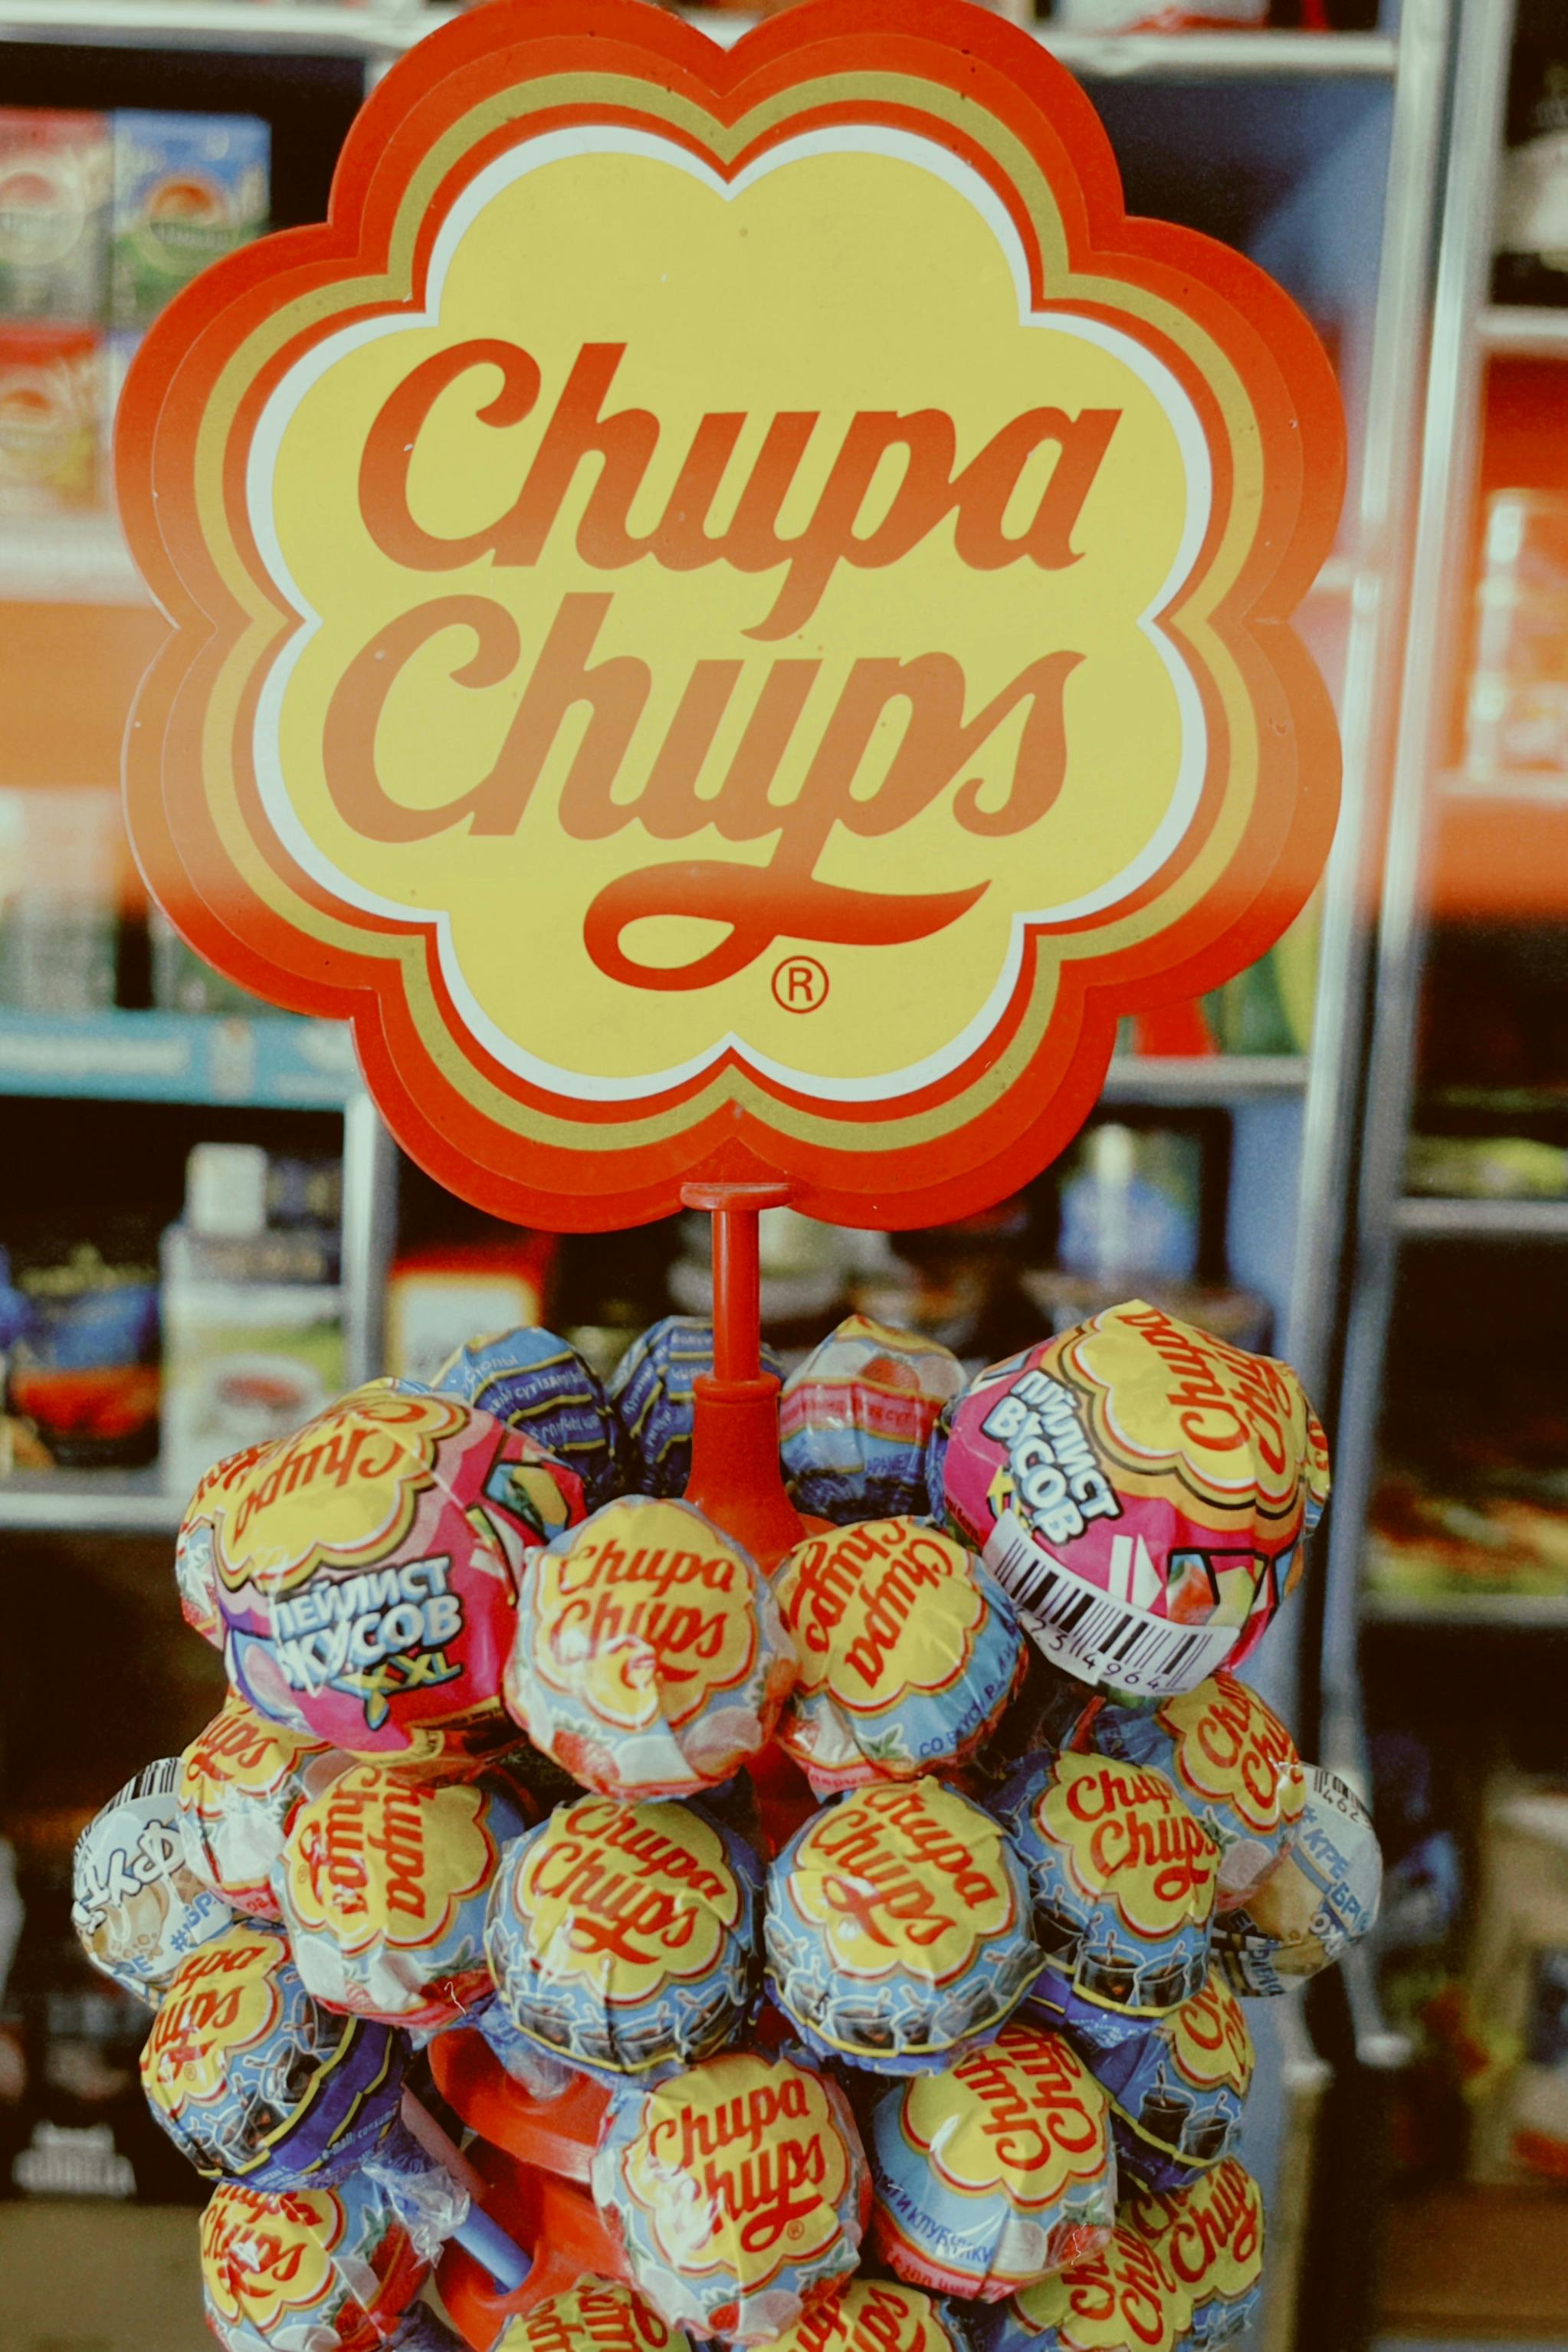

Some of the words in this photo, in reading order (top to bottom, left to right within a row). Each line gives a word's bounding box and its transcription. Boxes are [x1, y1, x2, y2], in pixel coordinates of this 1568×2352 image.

[357, 339, 1124, 641] Chupa
[321, 592, 1087, 992] Chups
[1116, 1308, 1251, 1452] Chupa
[232, 1427, 406, 1550] Chupa
[558, 1540, 735, 1597] Chupa
[789, 1520, 907, 1654] Chups
[845, 1538, 953, 1688] Chupa
[549, 1591, 729, 1690] Chups
[366, 1777, 437, 1920] hupa
[565, 1802, 727, 1901] Chupa
[863, 1787, 999, 1910] Chupa
[1065, 1769, 1175, 1822] Chup
[530, 1841, 699, 1965] Chups
[810, 1809, 957, 1947] Chups
[649, 2078, 810, 2177] Chupa
[952, 2049, 1051, 2171] Chup
